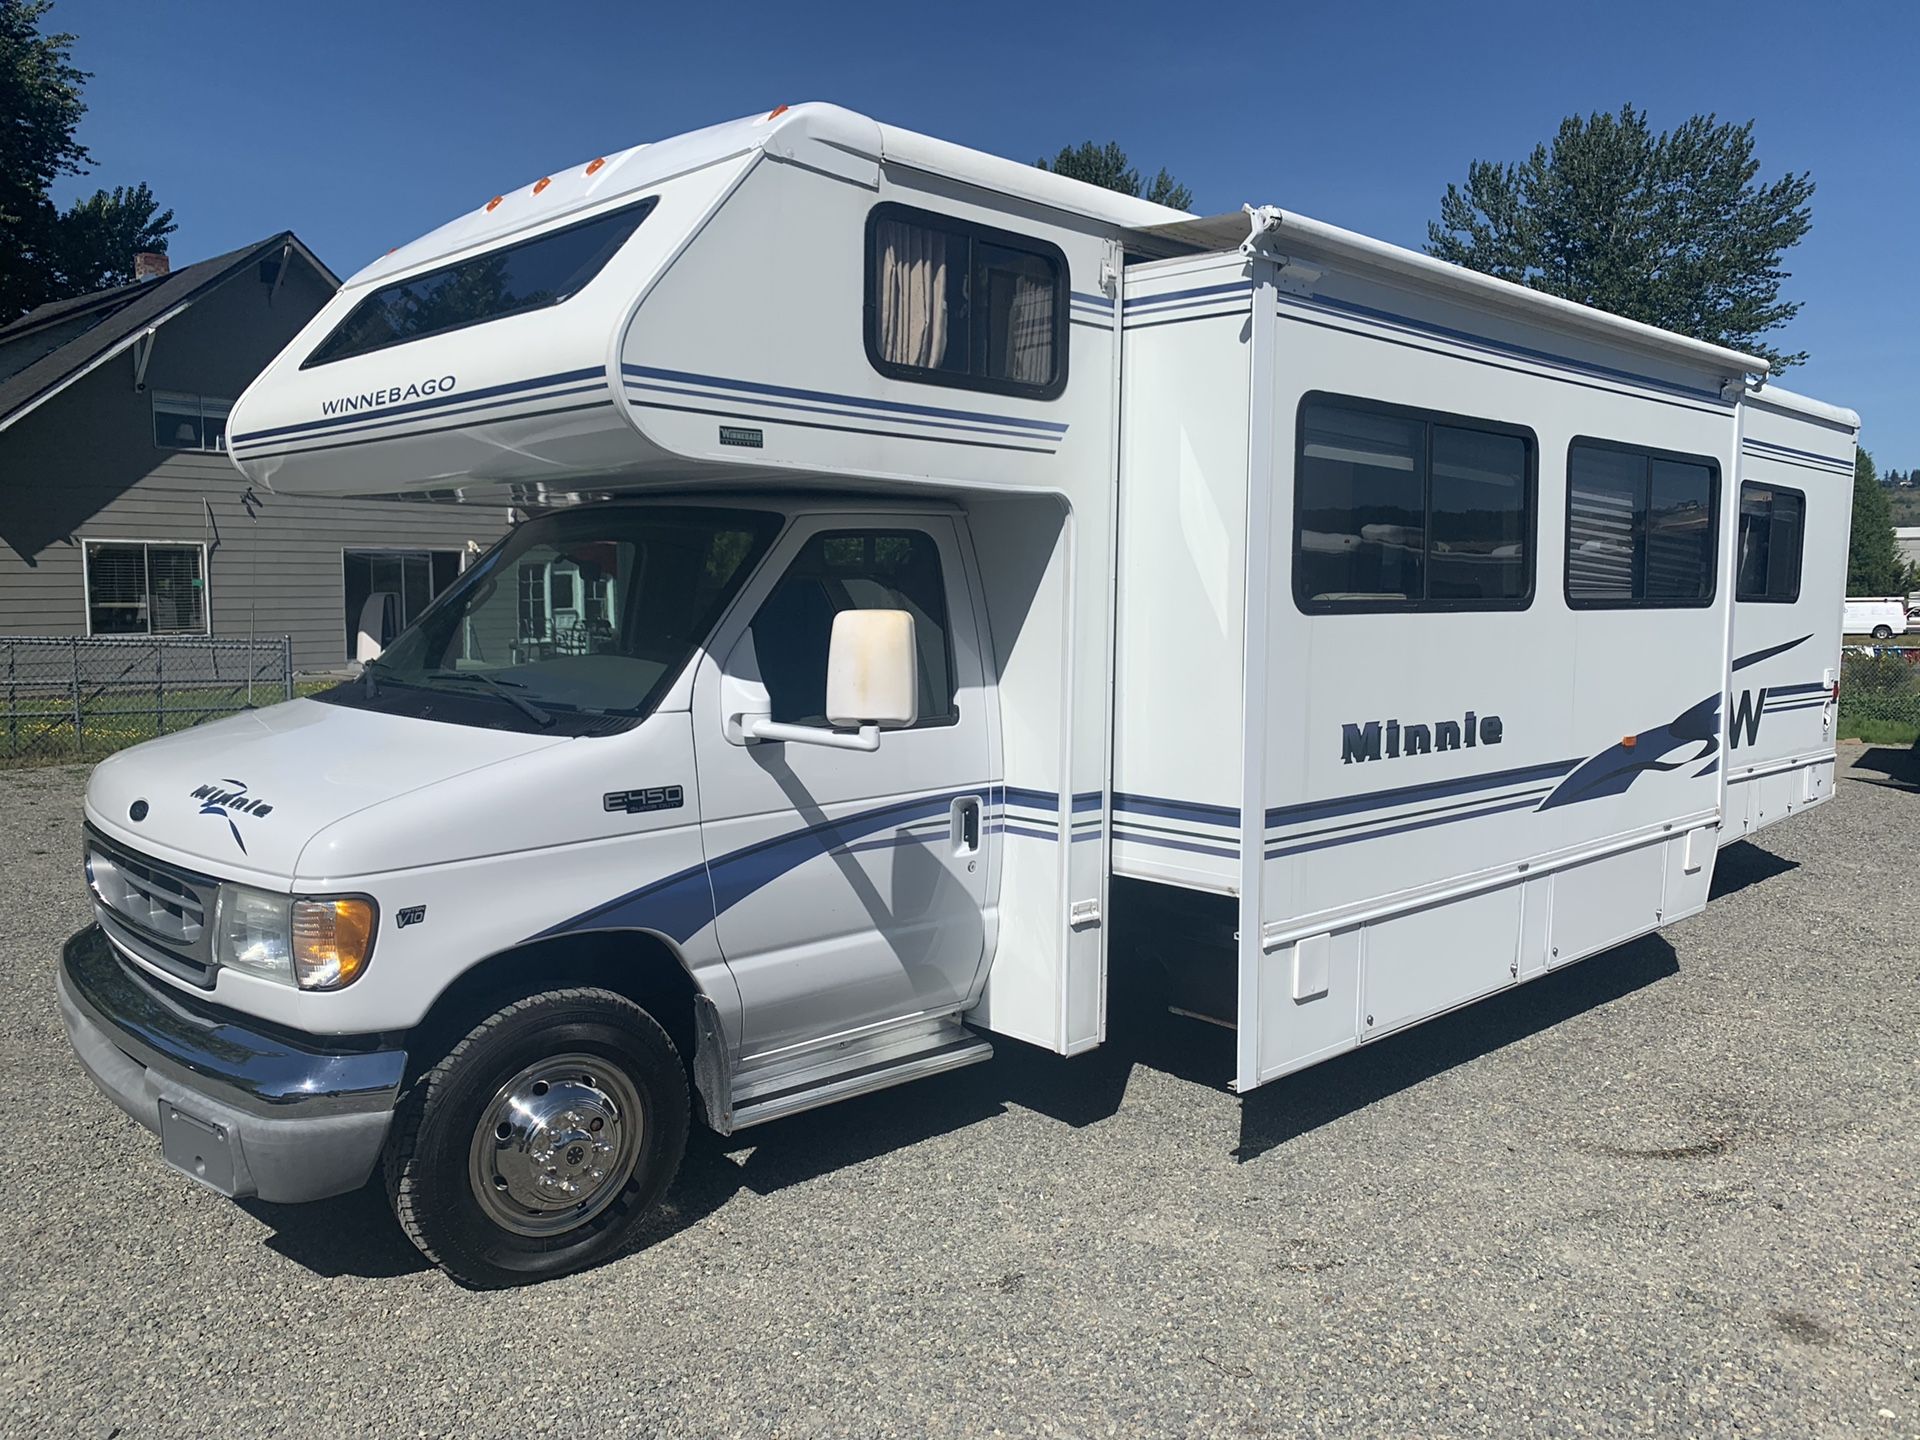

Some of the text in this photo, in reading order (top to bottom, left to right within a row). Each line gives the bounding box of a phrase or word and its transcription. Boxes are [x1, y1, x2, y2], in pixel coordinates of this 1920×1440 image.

[322, 375, 456, 415] WINNEBAGO
[1340, 711, 1503, 765] Minnie
[397, 911, 424, 927] V10
